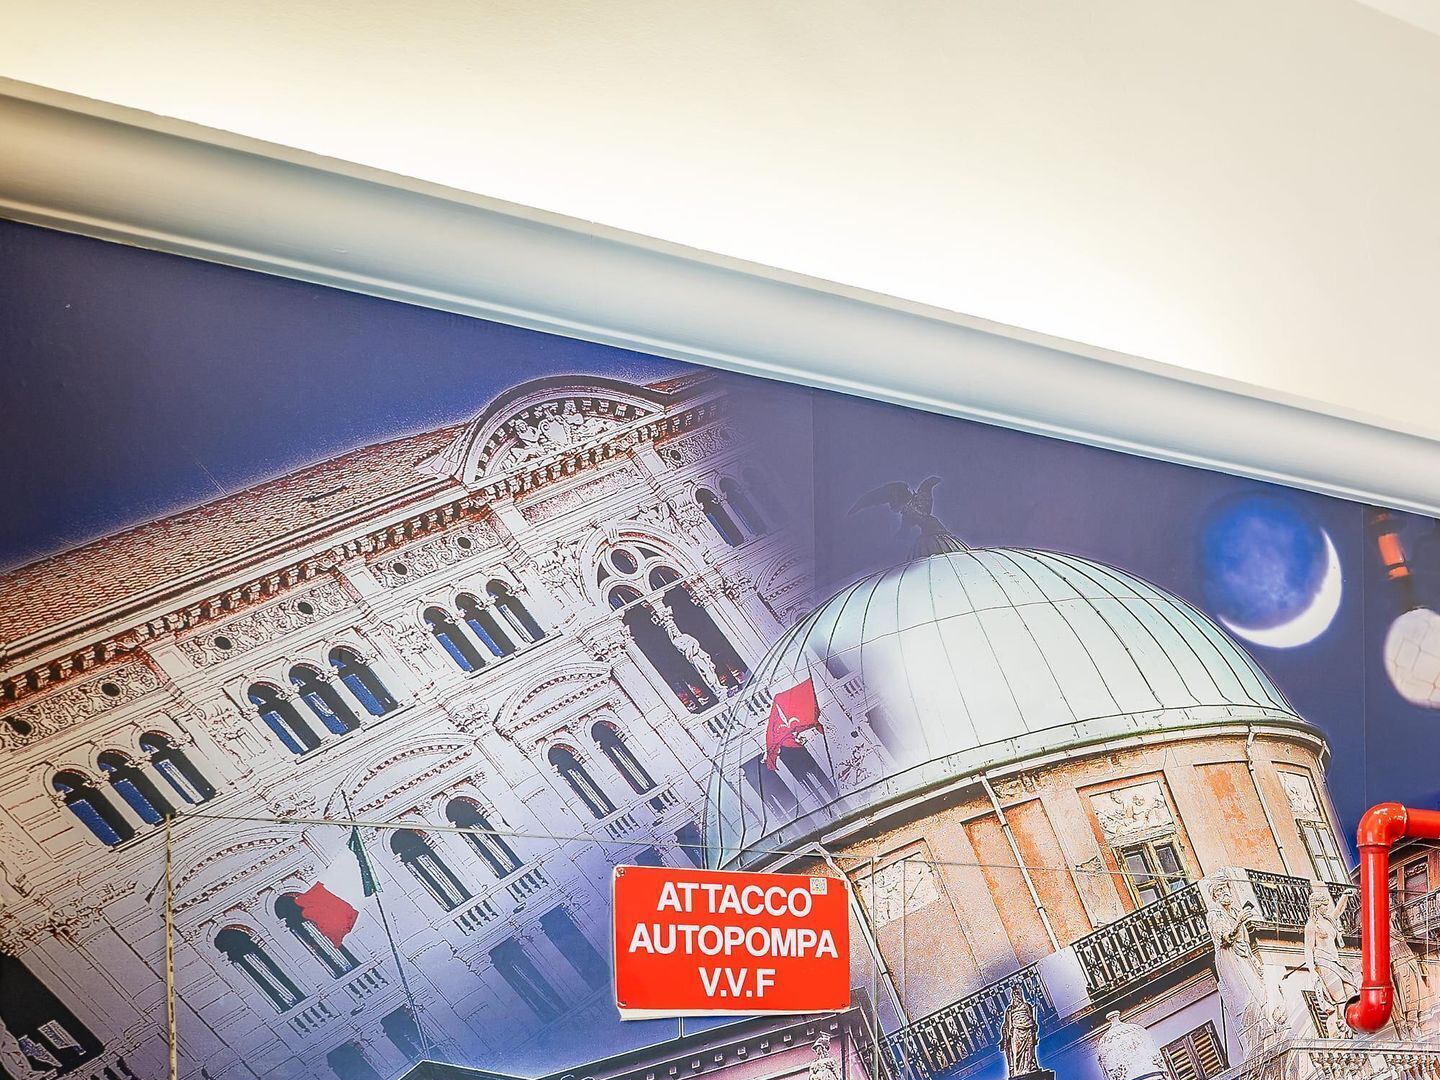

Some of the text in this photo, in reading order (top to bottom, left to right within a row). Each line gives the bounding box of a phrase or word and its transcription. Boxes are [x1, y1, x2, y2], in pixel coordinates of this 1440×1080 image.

[656, 881, 813, 918] ATTACCO
[628, 922, 839, 959] AUTOPOMPA
[698, 967, 776, 998] V.V.F
